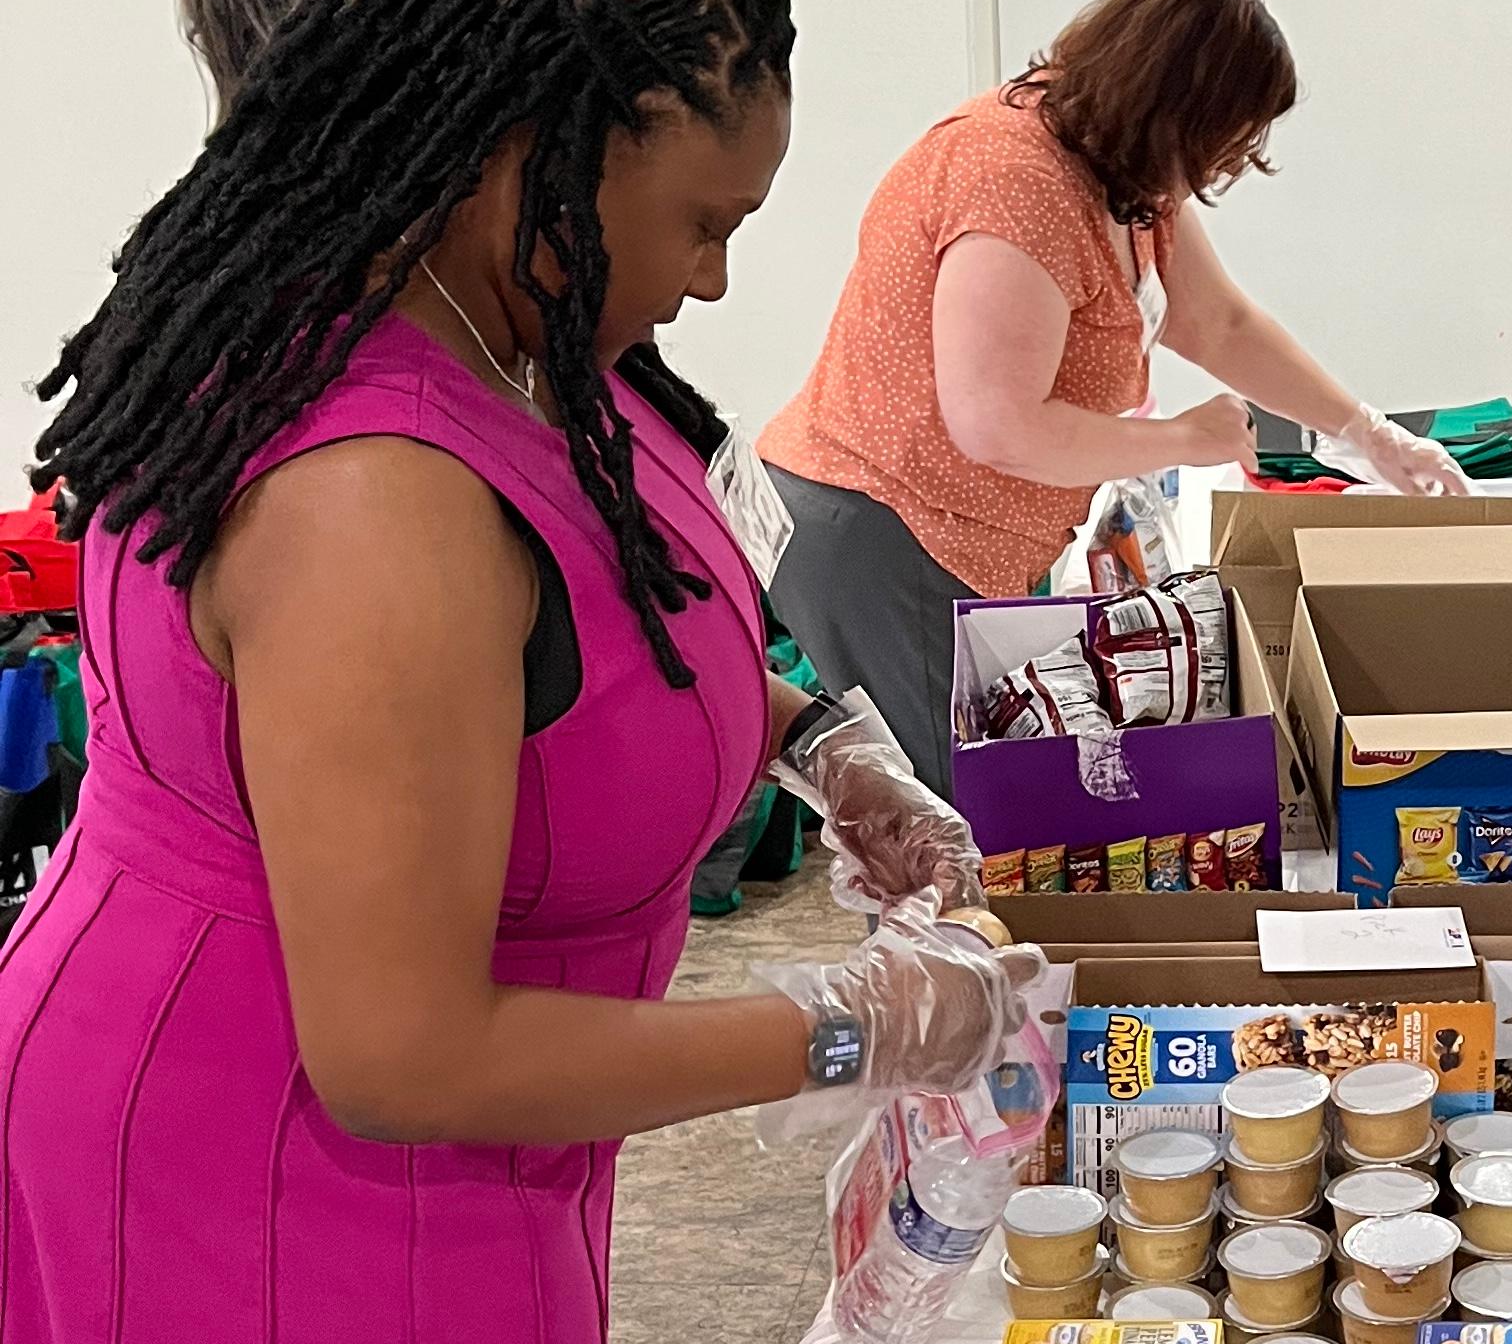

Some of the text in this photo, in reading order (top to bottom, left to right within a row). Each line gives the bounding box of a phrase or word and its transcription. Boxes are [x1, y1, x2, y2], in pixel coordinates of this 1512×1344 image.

[1168, 1037, 1197, 1077] 60
[1197, 1034, 1206, 1079] GRANOLA
[1207, 1045, 1216, 1068] BARS
[1105, 1169, 1115, 1189] 100
